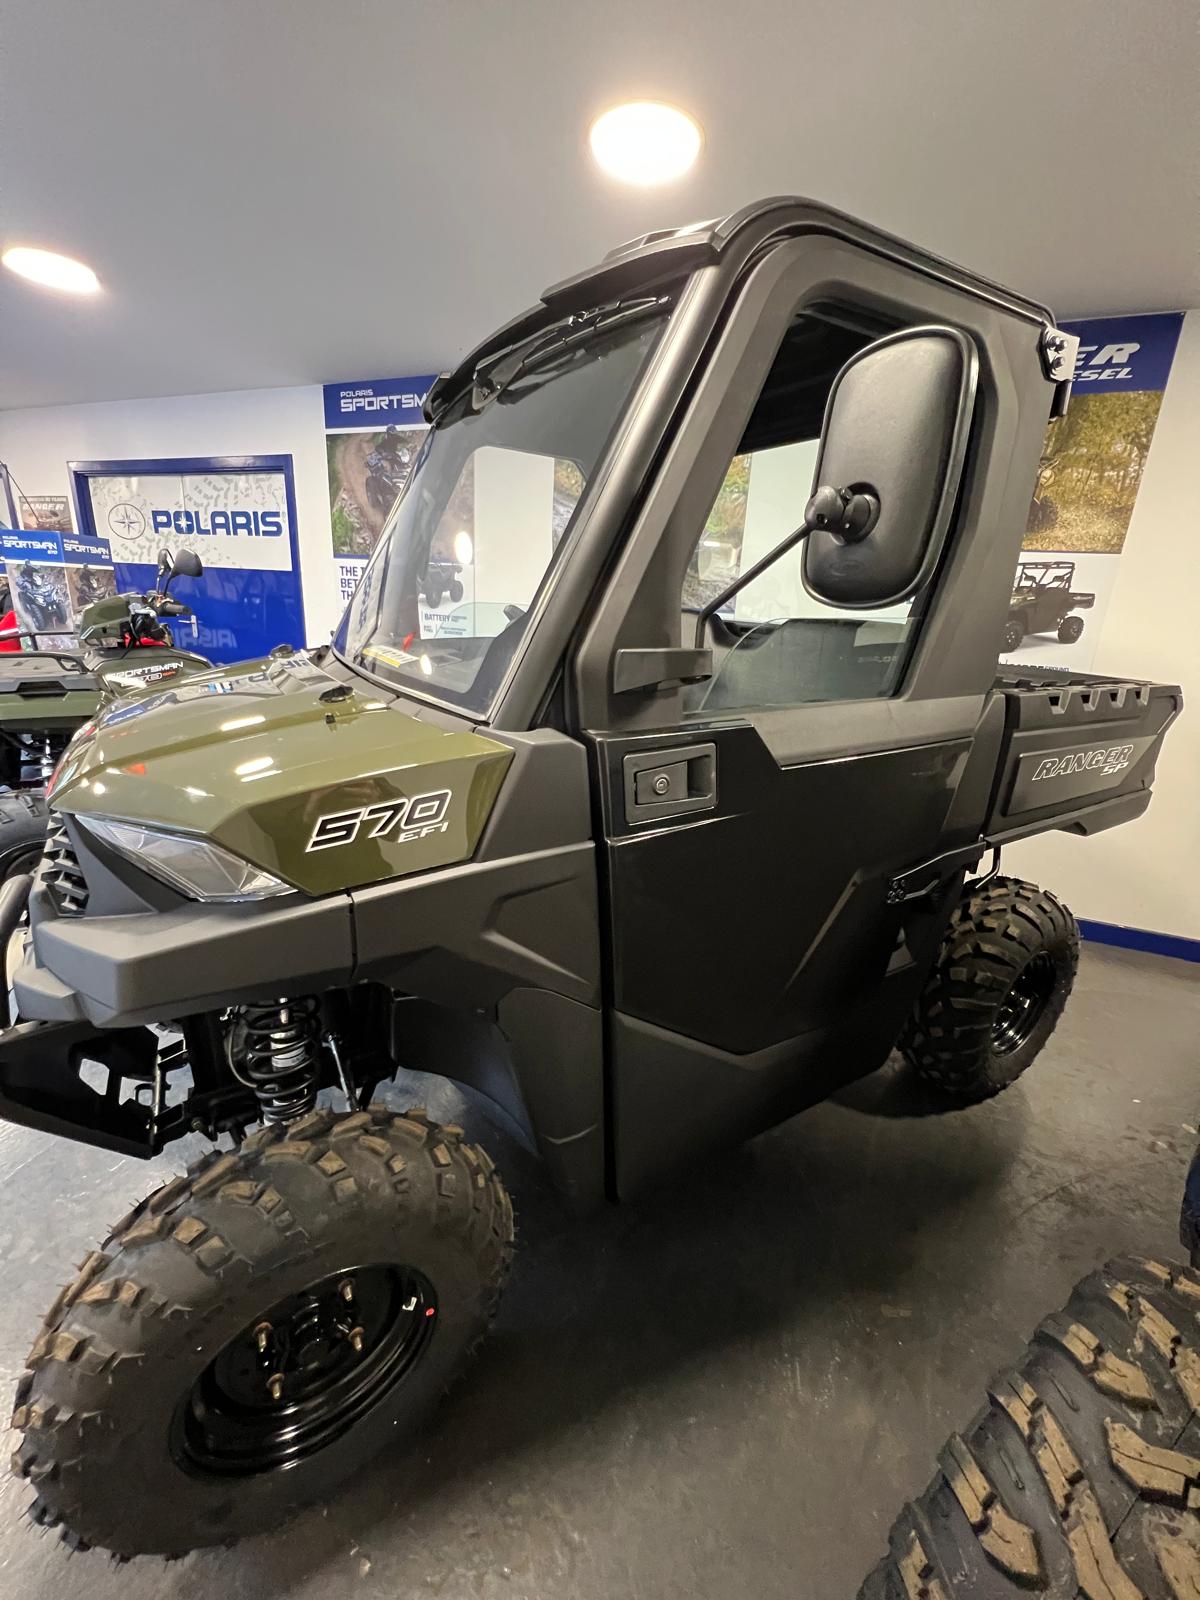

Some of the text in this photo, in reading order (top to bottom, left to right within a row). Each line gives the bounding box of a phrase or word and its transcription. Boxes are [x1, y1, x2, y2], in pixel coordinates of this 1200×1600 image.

[340, 388, 374, 398] POLARIS
[151, 510, 282, 537] POLARIS
[3, 540, 58, 550] SPORTSMAN
[63, 543, 109, 555] SPORTSMAN
[339, 566, 359, 577] THE
[424, 613, 450, 622] BATTERY
[106, 661, 184, 681] SPORTSMAN
[1032, 744, 1134, 781] RANGER
[1100, 761, 1129, 776] SP
[305, 789, 452, 853] 570
[397, 821, 449, 844] EFI
